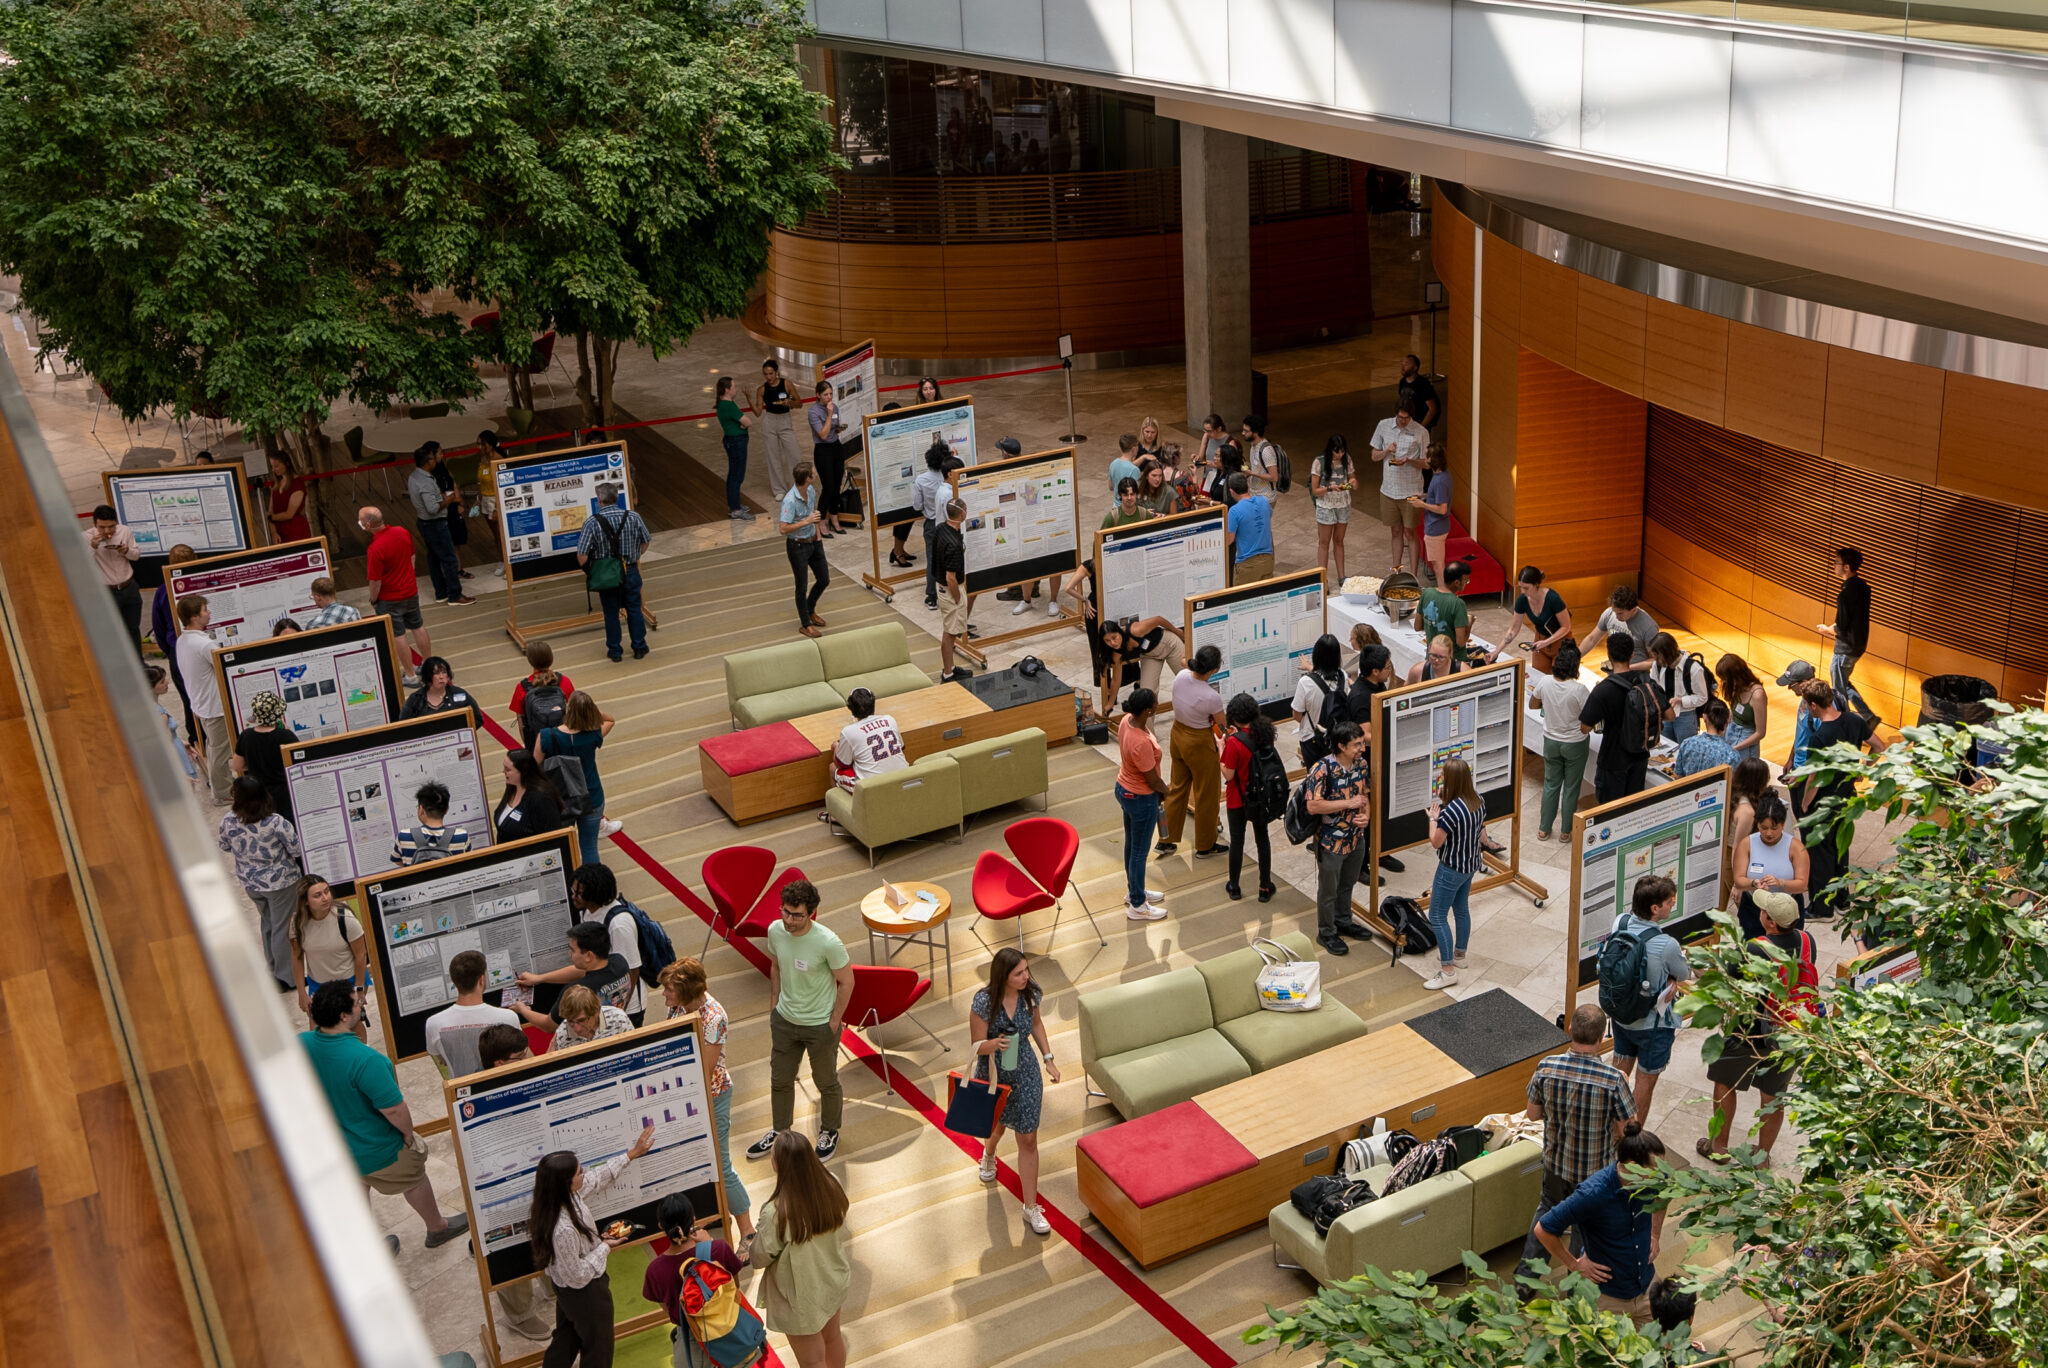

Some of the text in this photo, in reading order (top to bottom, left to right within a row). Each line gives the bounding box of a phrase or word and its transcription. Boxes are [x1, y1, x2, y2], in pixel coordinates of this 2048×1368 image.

[545, 478, 583, 491] NIAGARA
[860, 720, 890, 734] YELICH
[306, 762, 328, 770] Mercury
[358, 749, 390, 760] Microplastics
[396, 742, 422, 752] Freshwater
[422, 735, 456, 746] Environments
[866, 730, 902, 762] 22
[644, 1045, 690, 1063] Freshwater@UW
[486, 1092, 504, 1102] Effects
[510, 1084, 535, 1094] Methanol
[543, 1076, 564, 1086] Phenolic
[565, 1065, 596, 1078] Contaminant
[597, 1060, 620, 1070] Oxidation
[621, 1056, 632, 1064] with
